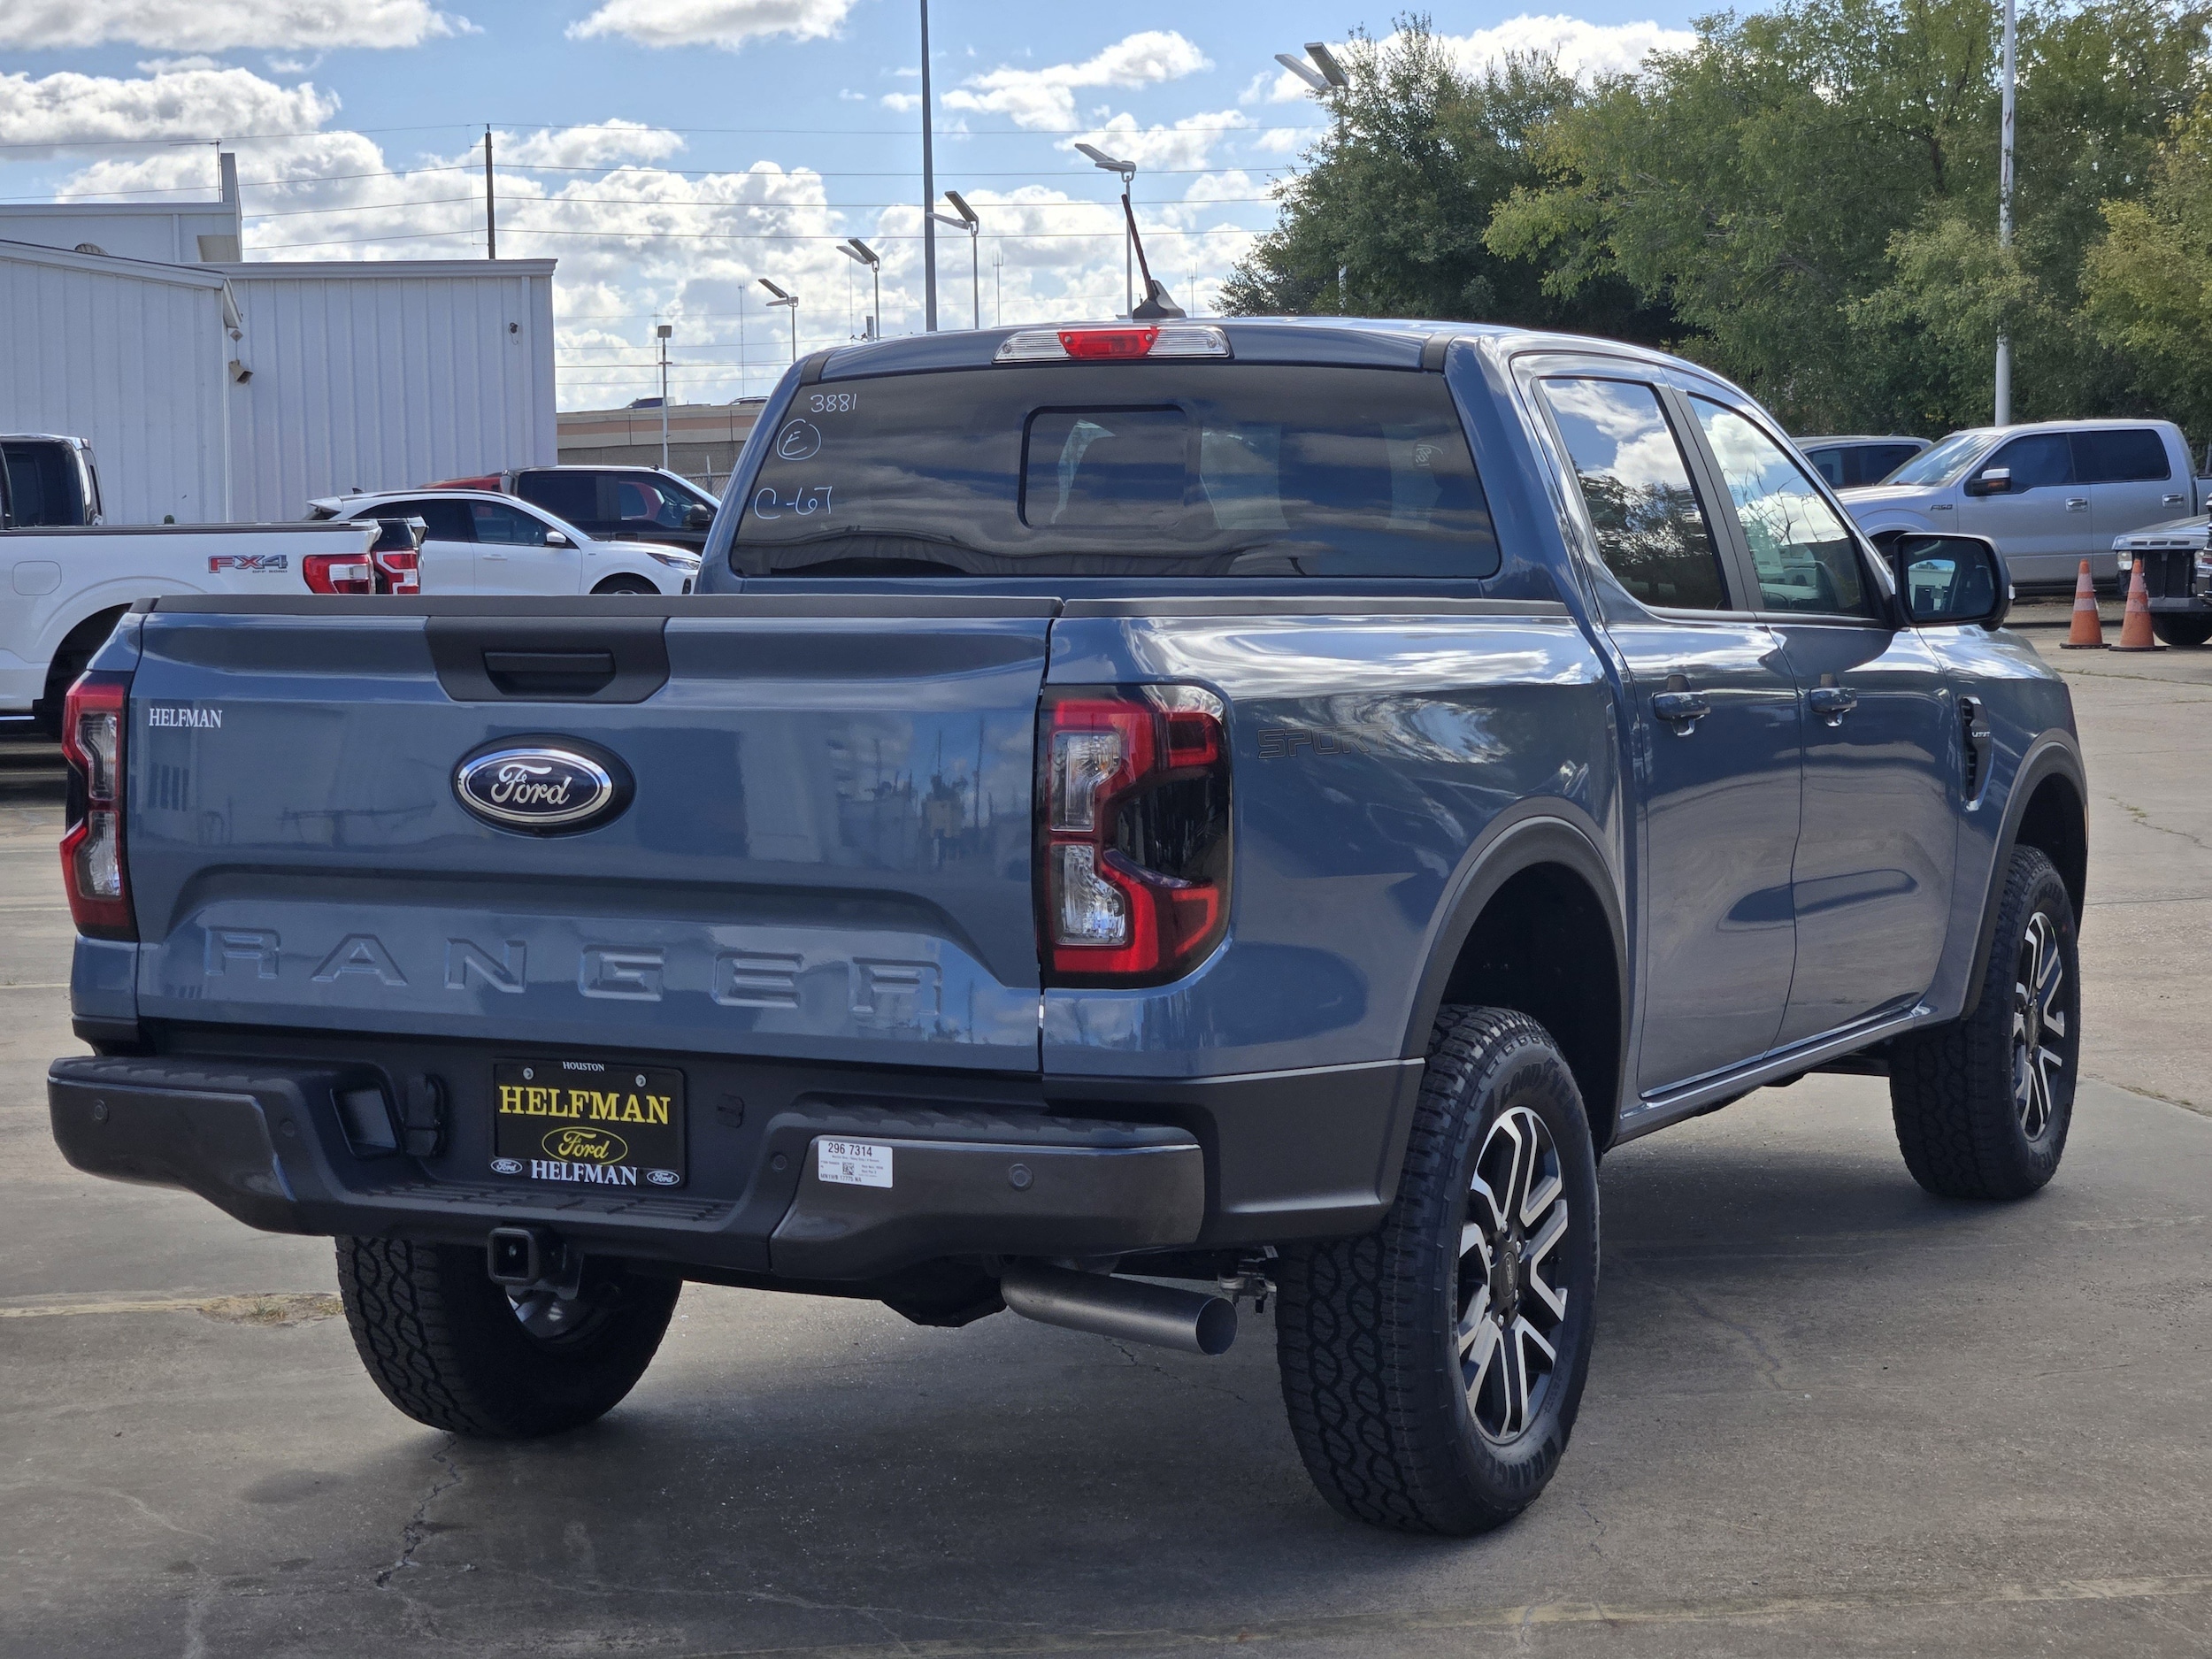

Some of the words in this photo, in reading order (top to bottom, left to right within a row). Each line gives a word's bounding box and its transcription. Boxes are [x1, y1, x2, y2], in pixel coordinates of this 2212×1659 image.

[810, 393, 857, 413] 3881
[754, 486, 833, 520] C-67
[208, 554, 288, 574] FX4
[149, 708, 223, 728] HELFMAN
[1257, 723, 1393, 759] SPORT
[490, 764, 572, 805] Ford
[204, 926, 943, 1017] RANGER
[562, 1061, 605, 1072] HOUSTON
[499, 1085, 672, 1125] HELFMAN
[557, 1130, 611, 1159] Ford
[828, 1142, 846, 1155] 296
[849, 1144, 872, 1156] 7314
[495, 1160, 518, 1173] Ford
[531, 1159, 638, 1187] HELFMAN
[652, 1171, 674, 1184] Ford
